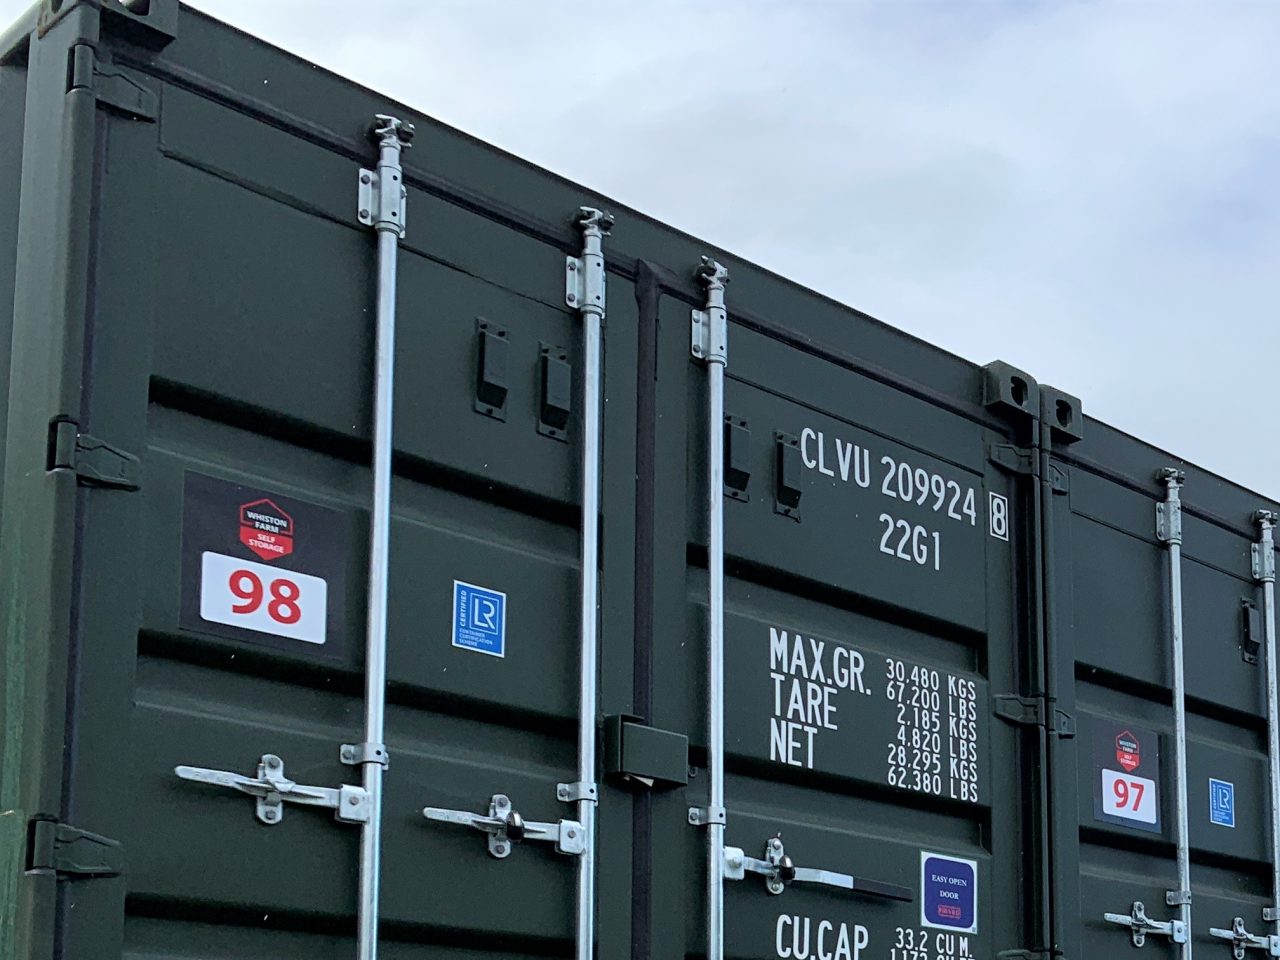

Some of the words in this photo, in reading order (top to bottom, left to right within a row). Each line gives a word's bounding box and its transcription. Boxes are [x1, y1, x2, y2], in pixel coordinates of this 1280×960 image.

[800, 427, 871, 488] CLVU
[880, 456, 977, 526] 209924
[991, 497, 1007, 536] 8
[246, 511, 288, 528] WHISTON
[255, 522, 279, 533] FARM
[248, 539, 284, 553] STORAGE
[257, 533, 275, 542] SELF
[878, 513, 941, 571] 22G1
[228, 569, 302, 625] 98
[474, 598, 495, 629] LR
[948, 675, 976, 701] KGS
[770, 672, 838, 730] TARE
[948, 696, 977, 721] LBS
[948, 718, 977, 742] KGS
[770, 718, 818, 769] NET
[950, 737, 977, 762] LBS
[950, 758, 978, 782] KGS
[950, 778, 978, 803] LBS
[1113, 779, 1145, 812] 97
[931, 874, 948, 884] EASY
[949, 877, 967, 887] OPEN
[939, 890, 959, 900] DOOR
[895, 927, 928, 952] 33.2
